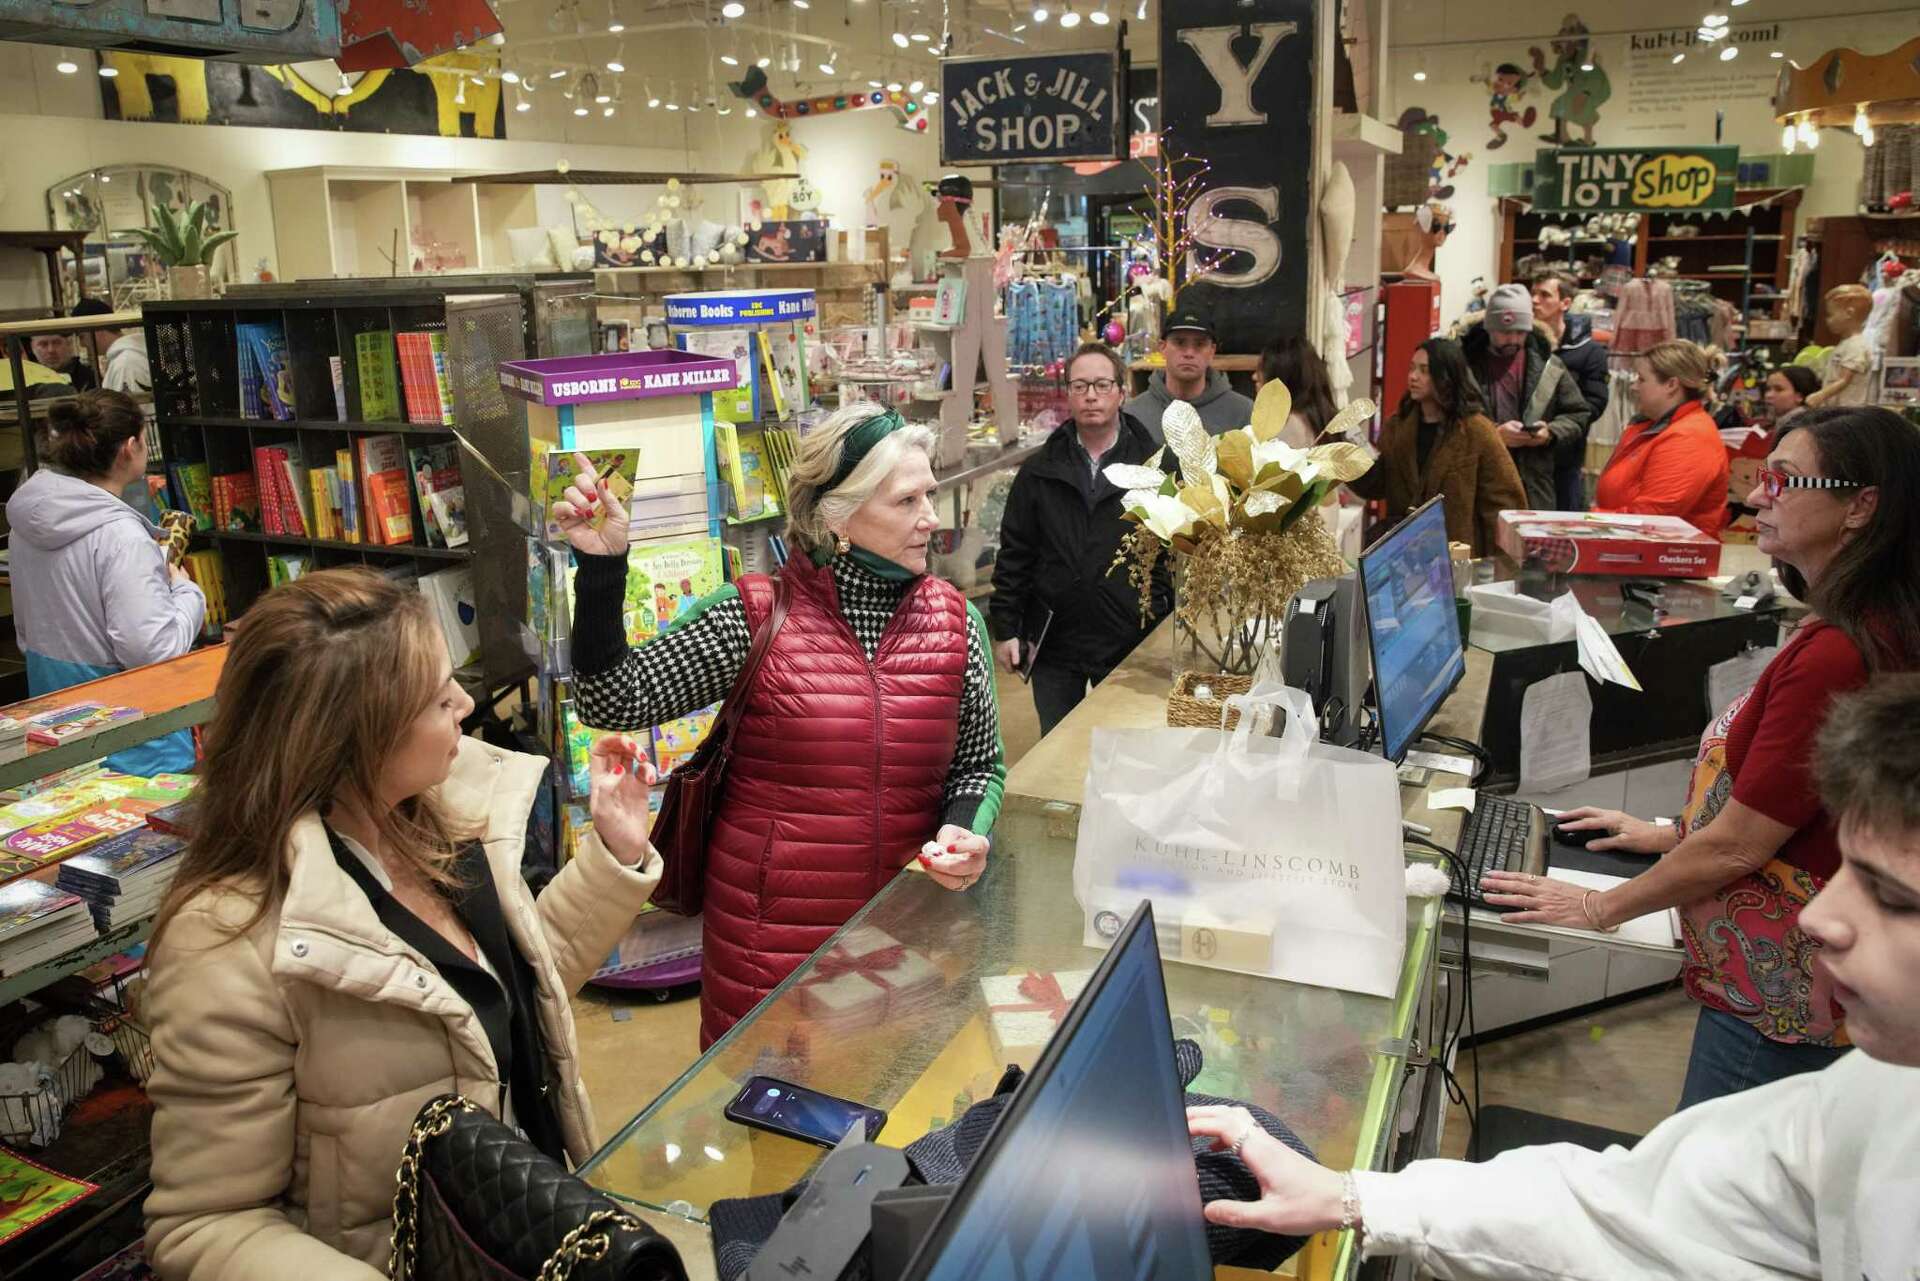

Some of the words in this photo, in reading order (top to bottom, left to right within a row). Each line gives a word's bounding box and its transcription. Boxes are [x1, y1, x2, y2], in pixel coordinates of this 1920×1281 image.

[951, 67, 1015, 126] JACK
[1024, 73, 1040, 96] &
[1046, 68, 1107, 121] JILL
[975, 114, 1080, 152] SHOP
[1130, 137, 1156, 155] OP
[1177, 21, 1297, 288] YS
[793, 191, 813, 202] BOY
[1557, 154, 1643, 207] TINY
[700, 303, 734, 318] Books
[778, 301, 800, 314] Kane
[552, 378, 617, 397] USBORNE
[644, 374, 679, 389] KANE
[682, 368, 731, 385] MILLER
[1658, 555, 1692, 564] Checkers
[1694, 556, 1707, 565] Set
[1135, 836, 1360, 879] KUHL-LINSCOMB
